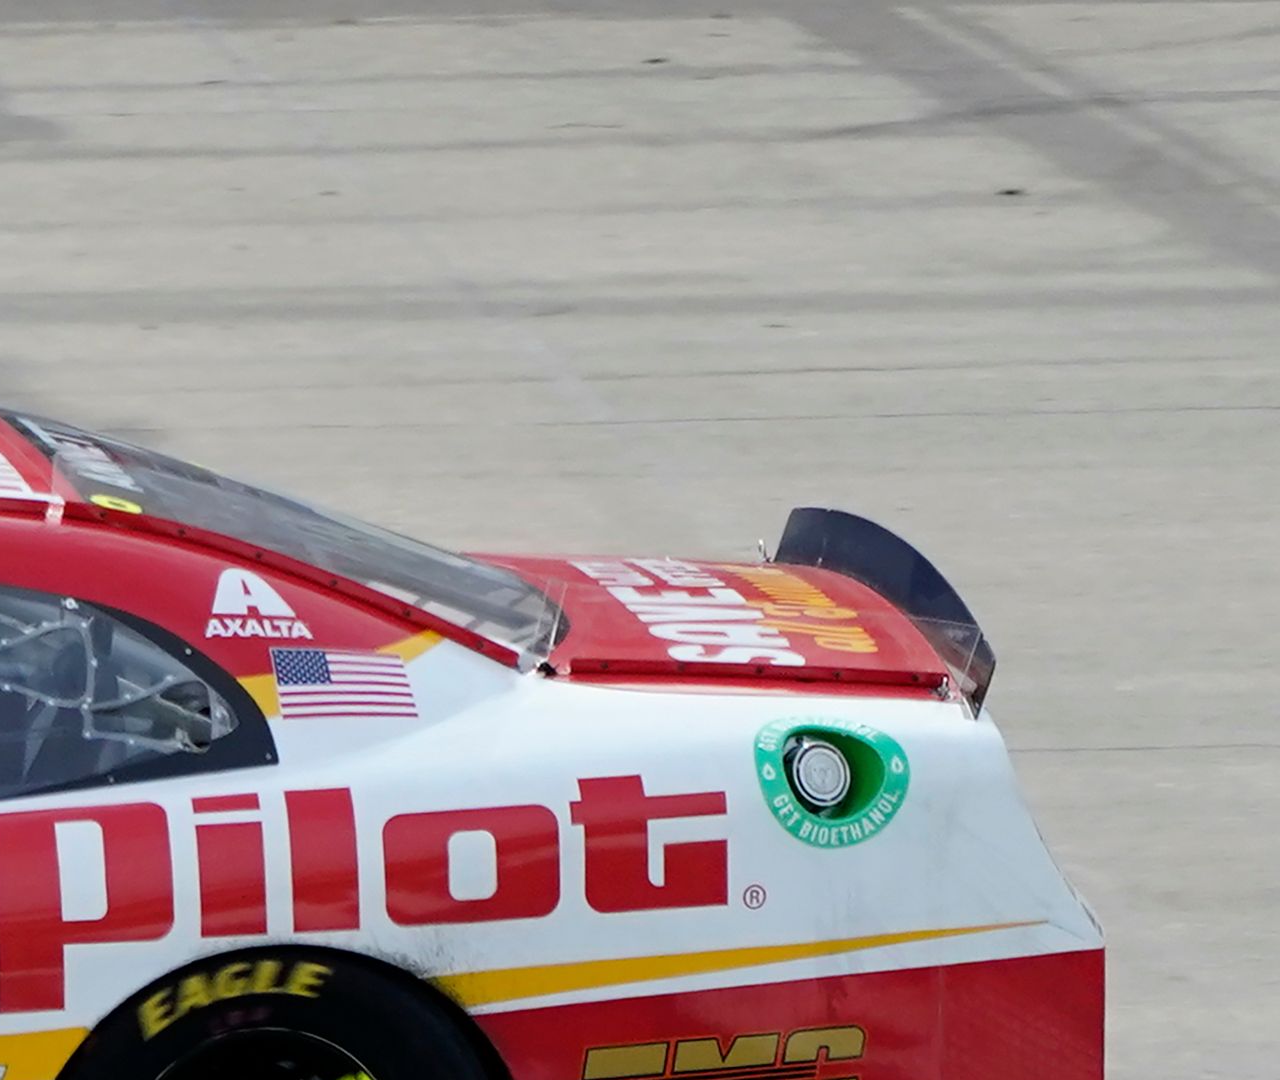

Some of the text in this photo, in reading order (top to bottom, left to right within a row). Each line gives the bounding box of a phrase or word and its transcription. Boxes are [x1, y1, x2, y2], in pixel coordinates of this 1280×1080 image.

[205, 617, 314, 640] AXALTA
[606, 586, 806, 666] SAVE
[773, 789, 901, 846] GET BIOETHANOL
[138, 959, 335, 1041] EAGLE
